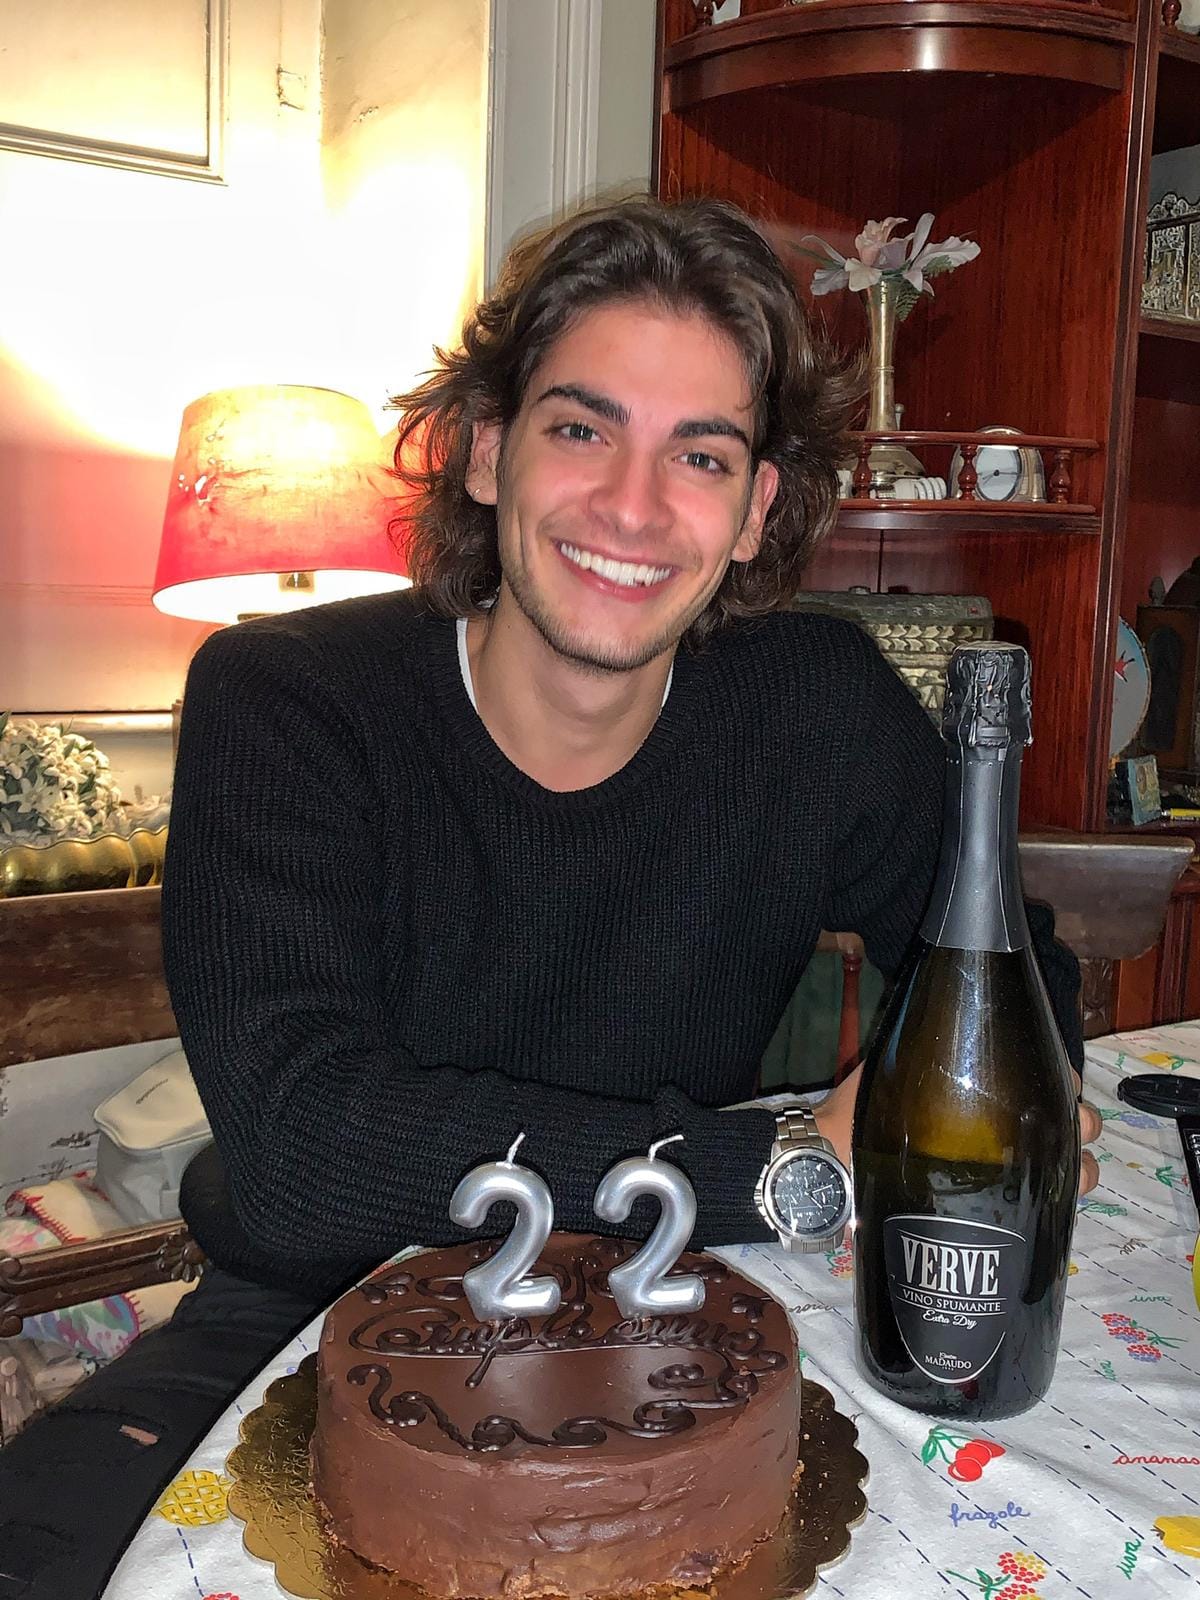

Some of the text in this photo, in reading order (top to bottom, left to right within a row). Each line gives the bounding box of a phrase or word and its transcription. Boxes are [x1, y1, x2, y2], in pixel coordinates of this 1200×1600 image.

[901, 1235, 1000, 1295] VERVE
[903, 1289, 1001, 1313] VINO SPUMANTE
[922, 1309, 978, 1330] Extra Dry
[924, 1355, 972, 1369] MADAUDO
[1112, 1455, 1200, 1465] ananas
[948, 1501, 1031, 1529] fragole
